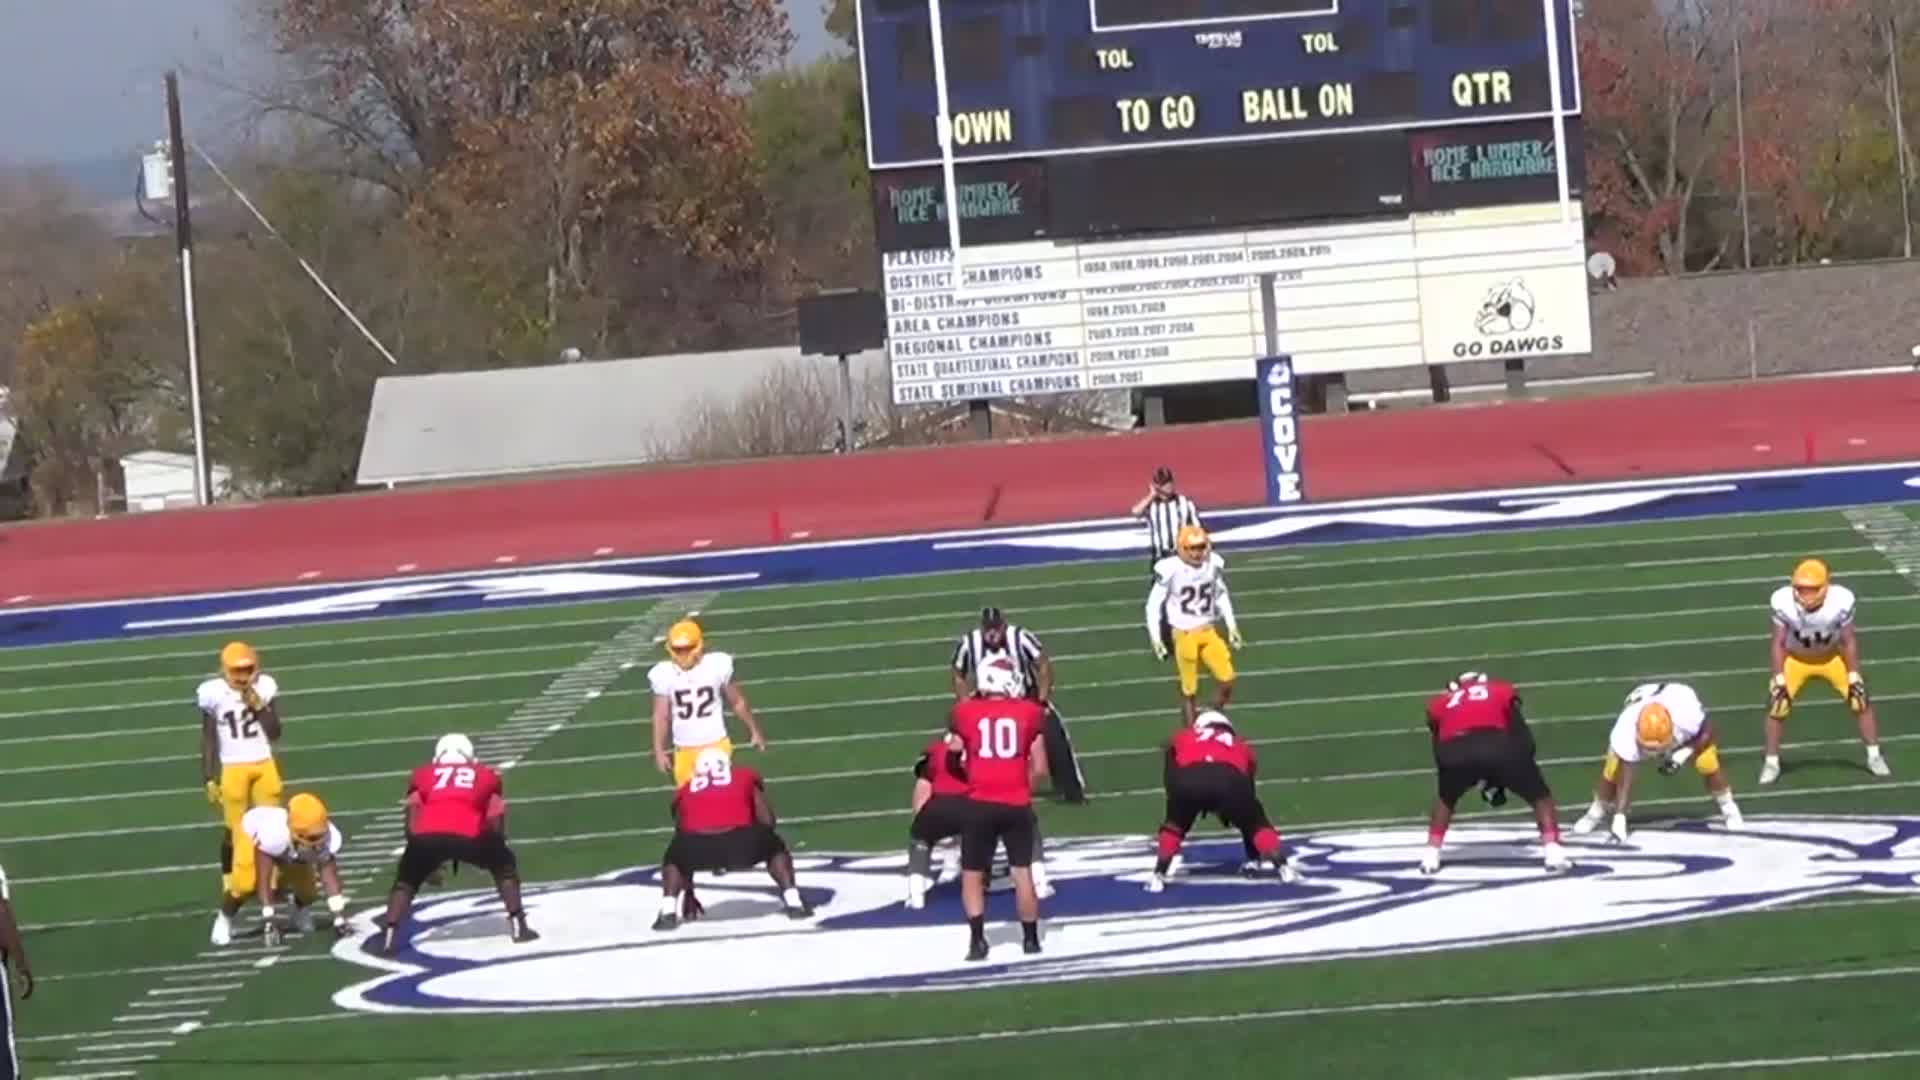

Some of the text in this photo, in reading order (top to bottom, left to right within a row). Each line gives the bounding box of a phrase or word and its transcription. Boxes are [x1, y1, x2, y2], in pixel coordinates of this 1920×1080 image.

[1303, 32, 1339, 54] TOL
[1097, 48, 1133, 69] TOL
[1452, 71, 1513, 107] QTR
[1117, 95, 1195, 133] TO GO
[1243, 83, 1354, 123] BALL ON
[889, 272, 952, 291] DISTRICT
[894, 311, 1020, 334] AREA CHAMPIONS
[894, 331, 1053, 356] REGIONAL CHAMPIONS
[1453, 335, 1564, 357] GO DAWGS
[897, 364, 928, 378] STATE
[1016, 351, 1080, 370] CHAMPIONS
[899, 385, 934, 401] STATE
[1008, 374, 1081, 394] CHAMPIONS
[1181, 583, 1215, 615] 25
[673, 687, 715, 721] 52
[221, 709, 260, 739] 12
[978, 717, 1018, 758] 10
[432, 767, 475, 790] 72
